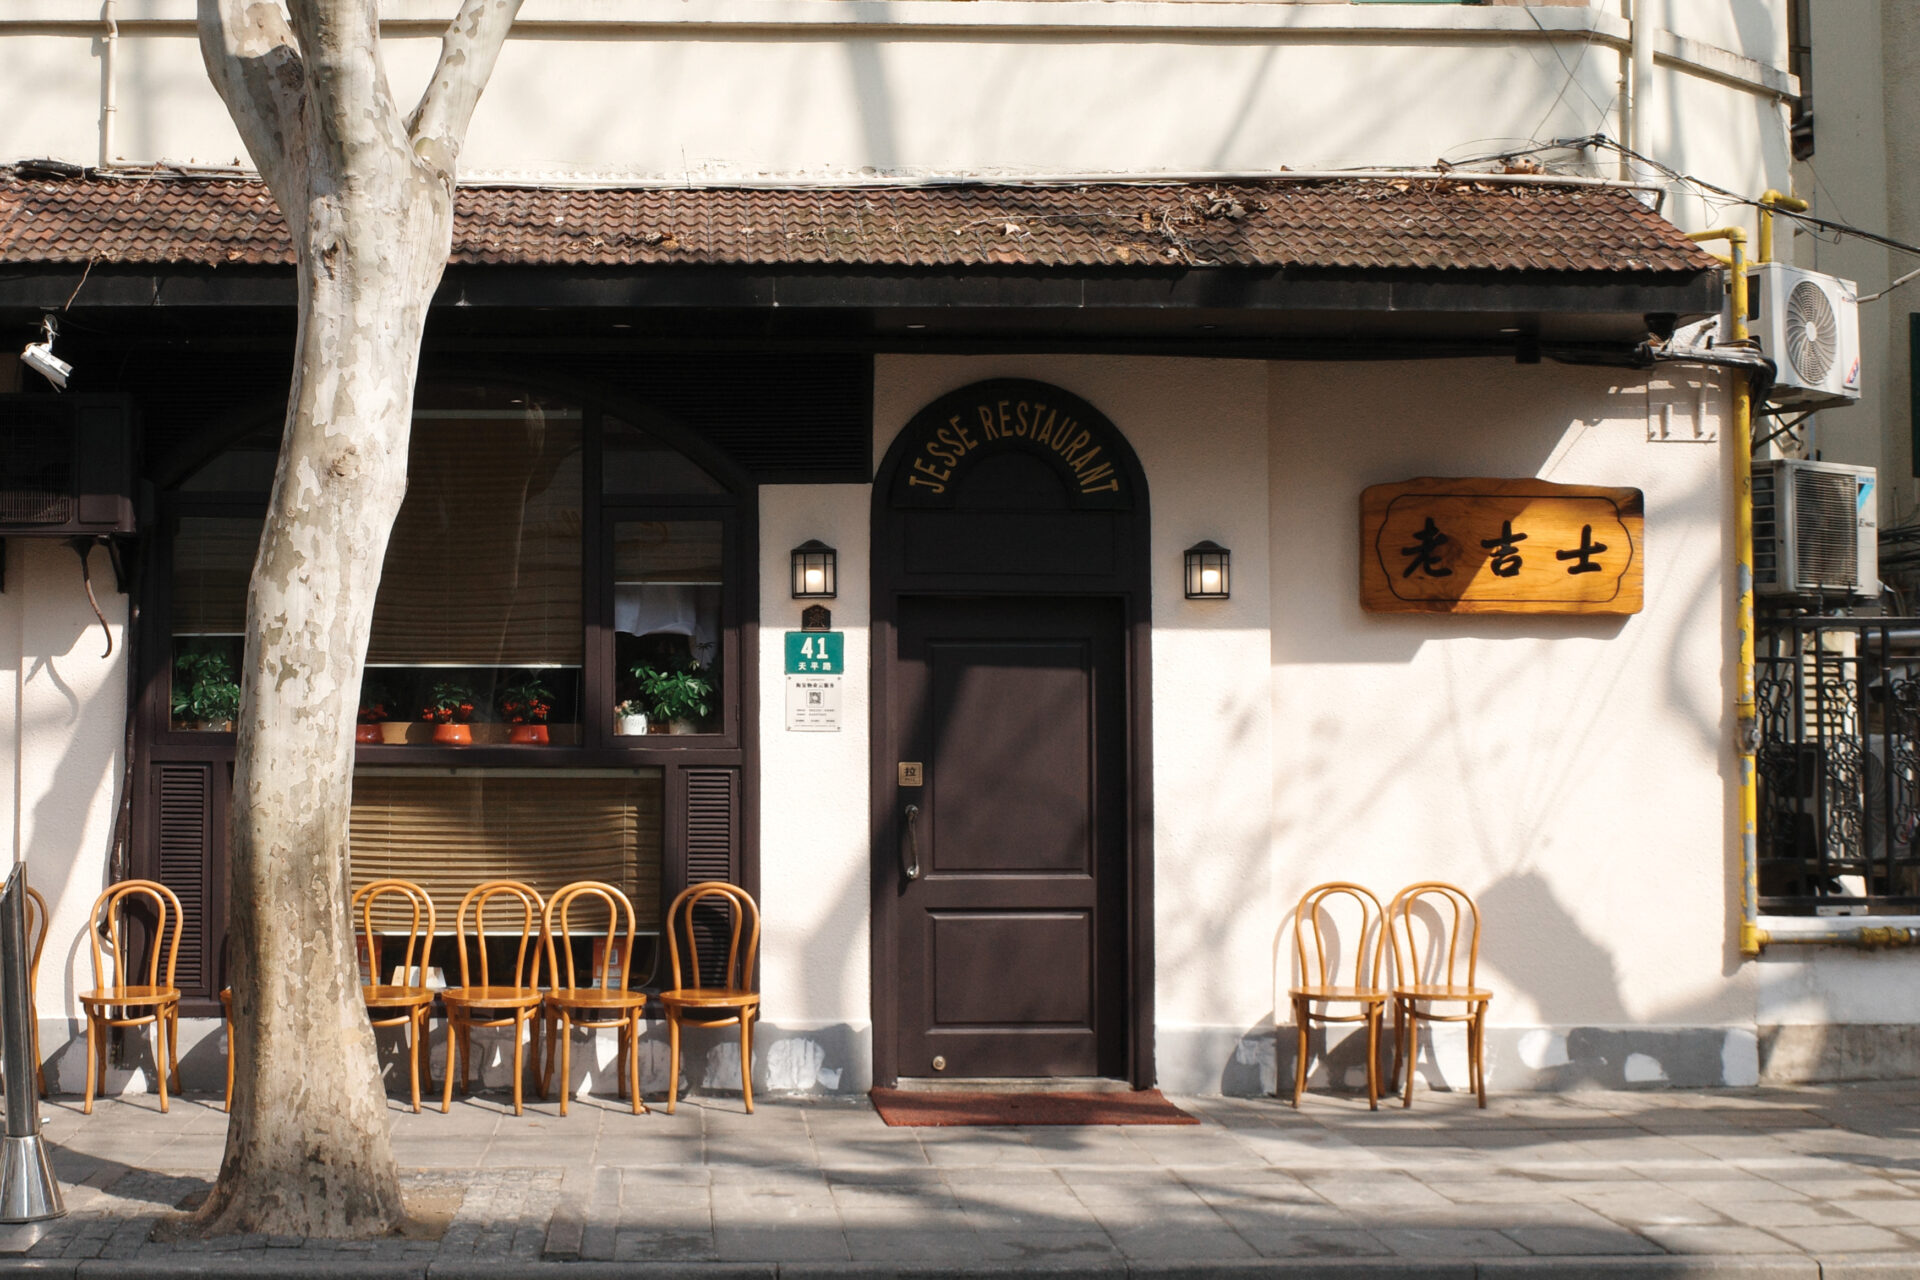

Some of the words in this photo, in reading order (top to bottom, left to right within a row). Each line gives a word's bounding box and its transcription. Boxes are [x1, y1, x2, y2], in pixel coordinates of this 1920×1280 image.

[909, 415, 978, 493] JESSE
[978, 401, 1119, 493] RESTAURANT
[1402, 517, 1607, 578] 老吉士
[798, 661, 832, 671] 天平路
[800, 637, 829, 659] 41
